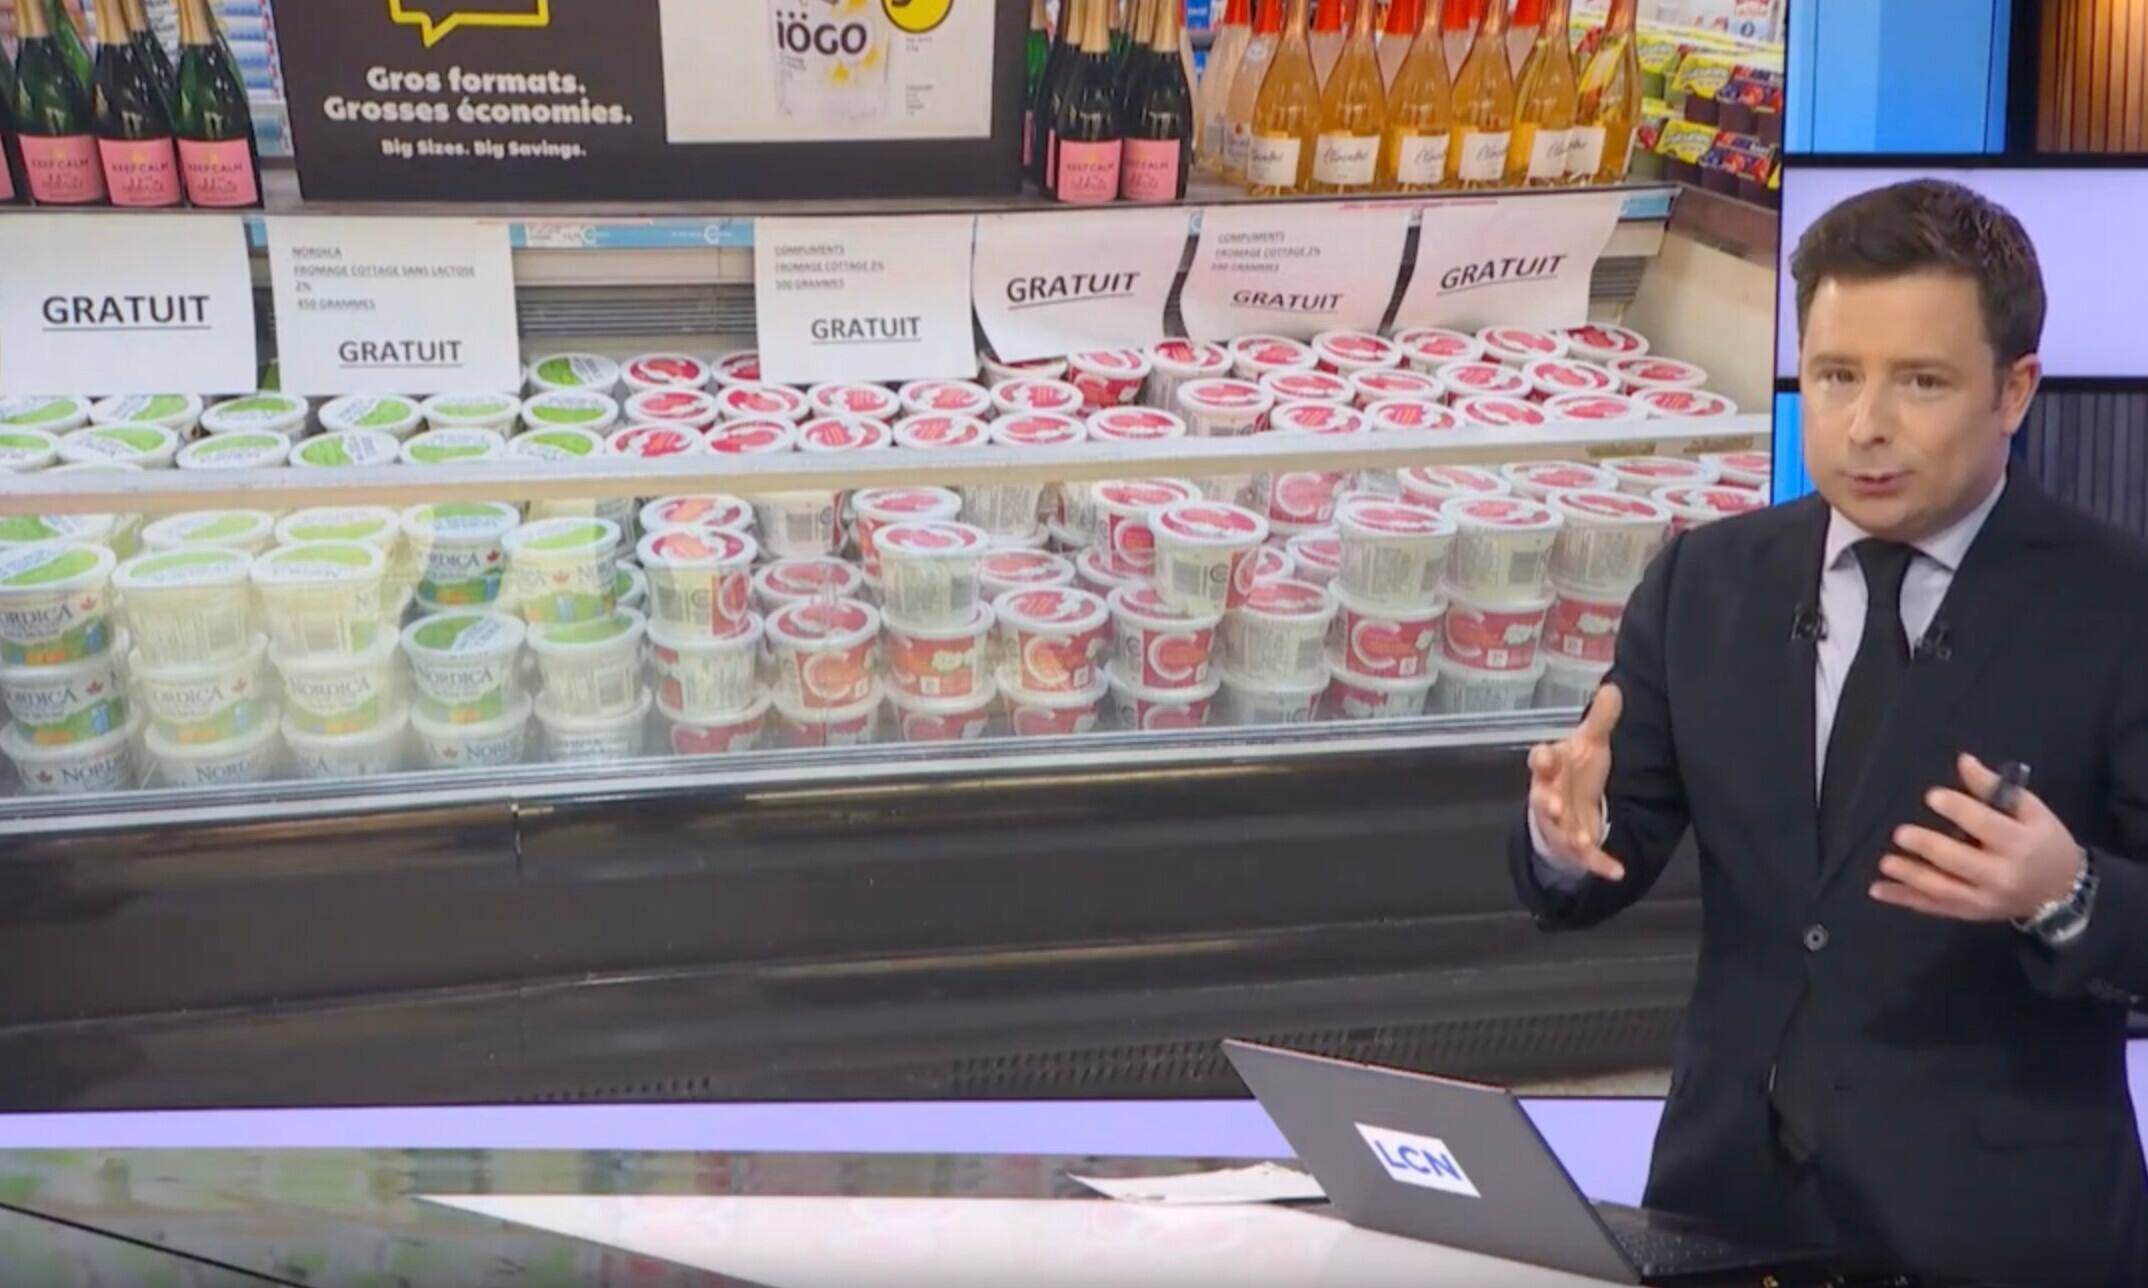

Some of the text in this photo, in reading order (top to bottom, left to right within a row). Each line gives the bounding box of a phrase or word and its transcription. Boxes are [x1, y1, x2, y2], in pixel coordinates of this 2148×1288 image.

[366, 66, 586, 94] Gros formats.
[323, 97, 633, 124] Grosses économies.
[381, 138, 587, 159] Big Sizes. Big Savings.
[294, 265, 476, 277] FROMAGE COTTAGE SANS LACTOSE
[1438, 254, 1568, 290] GRATUIT
[1006, 272, 1141, 303] GRATUIT
[1231, 289, 1344, 311] GRATUIT
[42, 296, 211, 325] GRATUIT
[319, 299, 375, 311] GRAMMES
[811, 316, 922, 340] GRATUIT
[338, 340, 463, 363] GRATUIT
[1373, 1139, 1463, 1182] LCN
